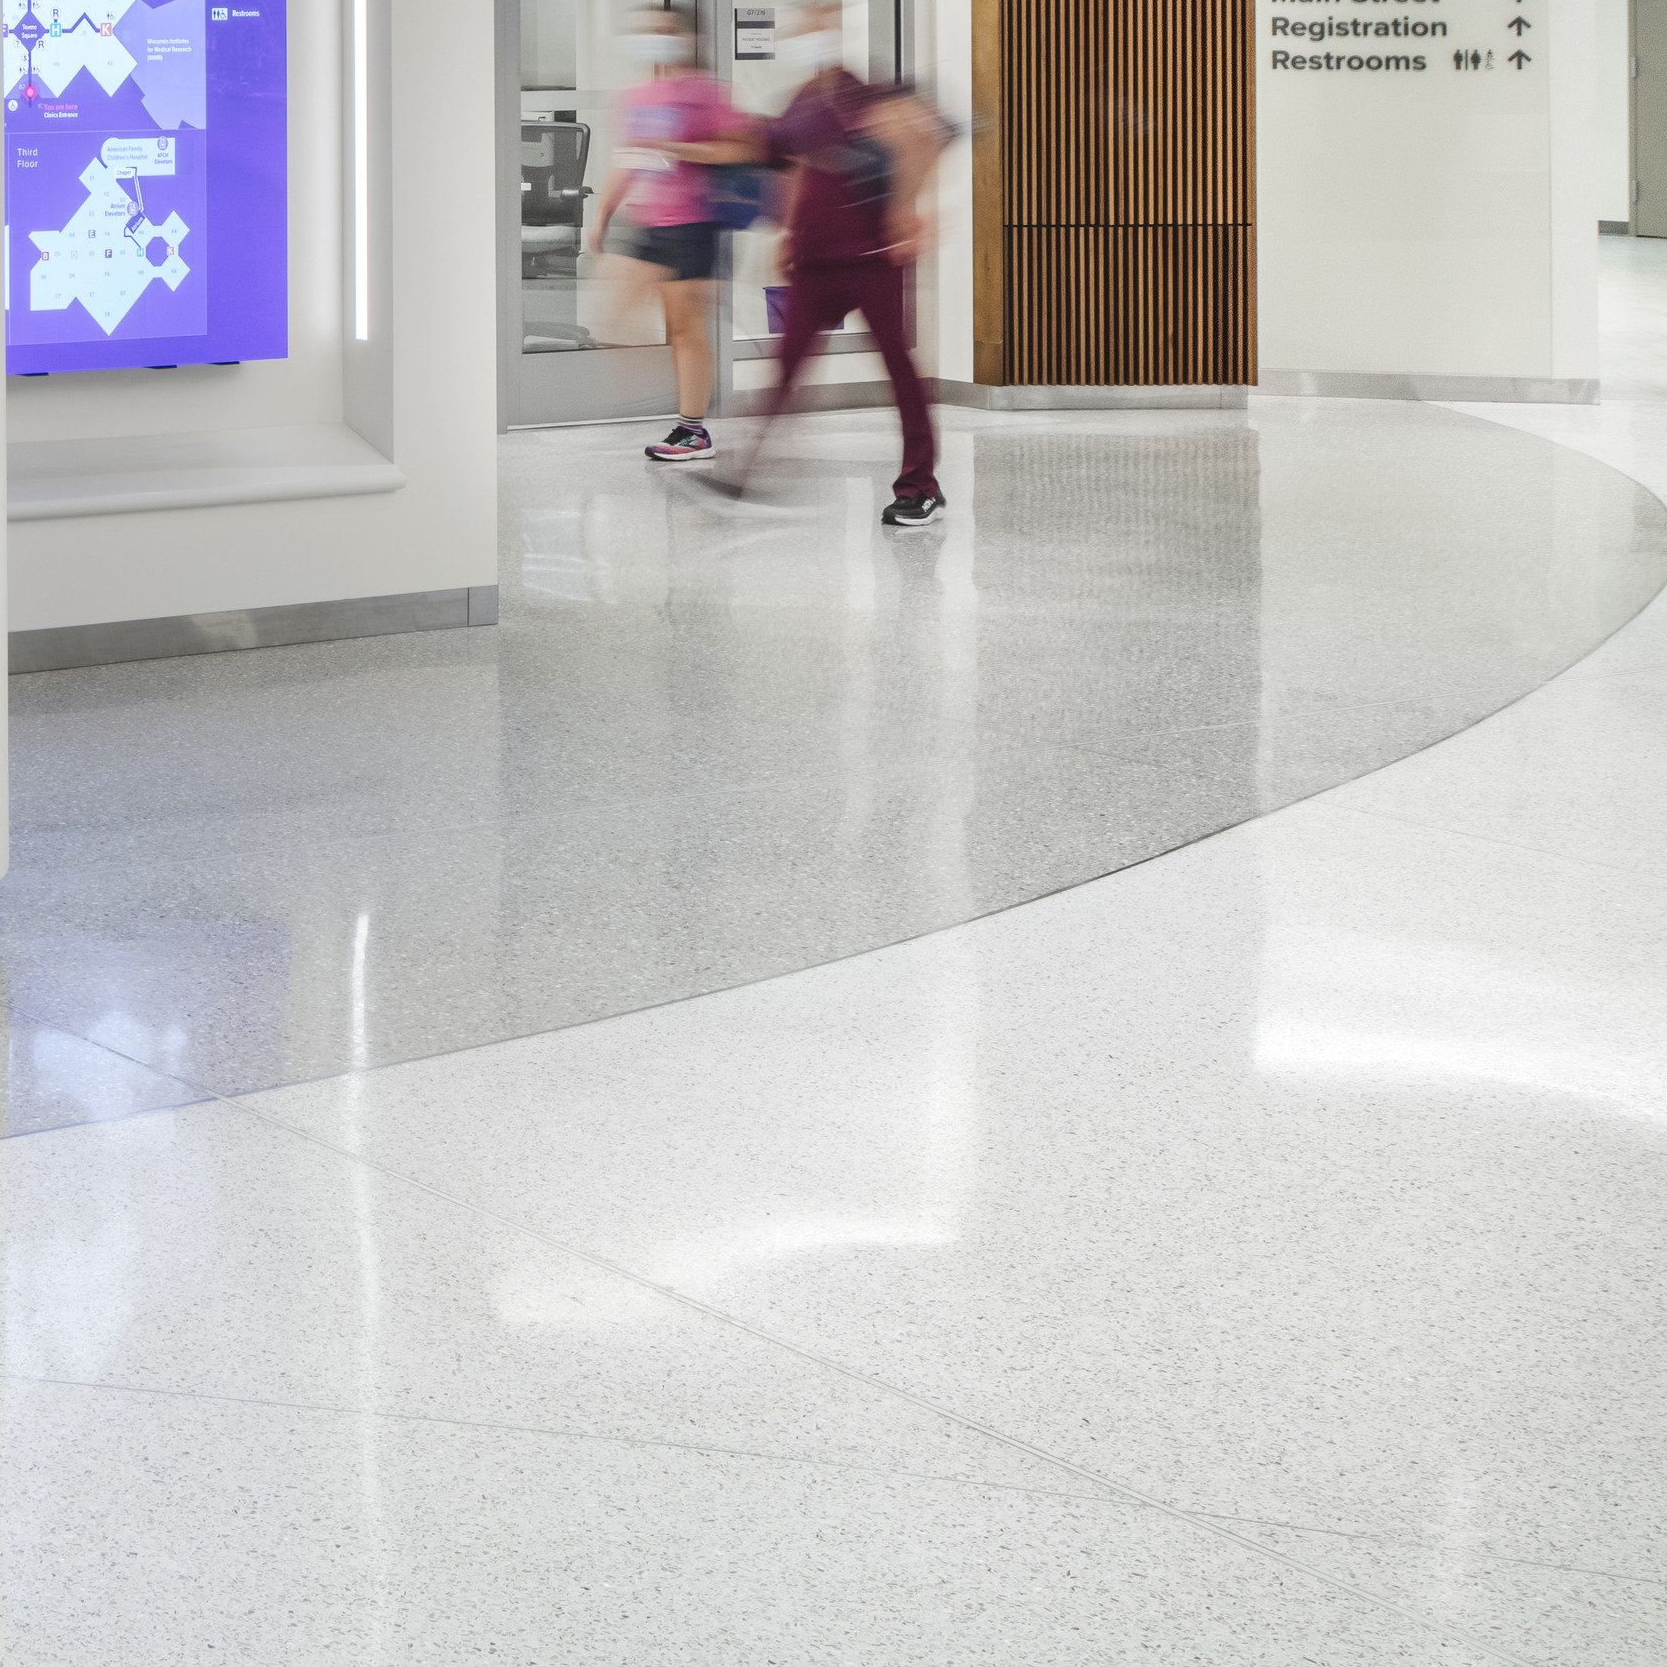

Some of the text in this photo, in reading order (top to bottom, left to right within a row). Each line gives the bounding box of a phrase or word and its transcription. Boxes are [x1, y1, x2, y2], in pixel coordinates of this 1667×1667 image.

[1271, 15, 1448, 42] Registration
[1271, 50, 1427, 71] Restrooms
[17, 148, 38, 157] Third
[17, 160, 38, 168] Floor
